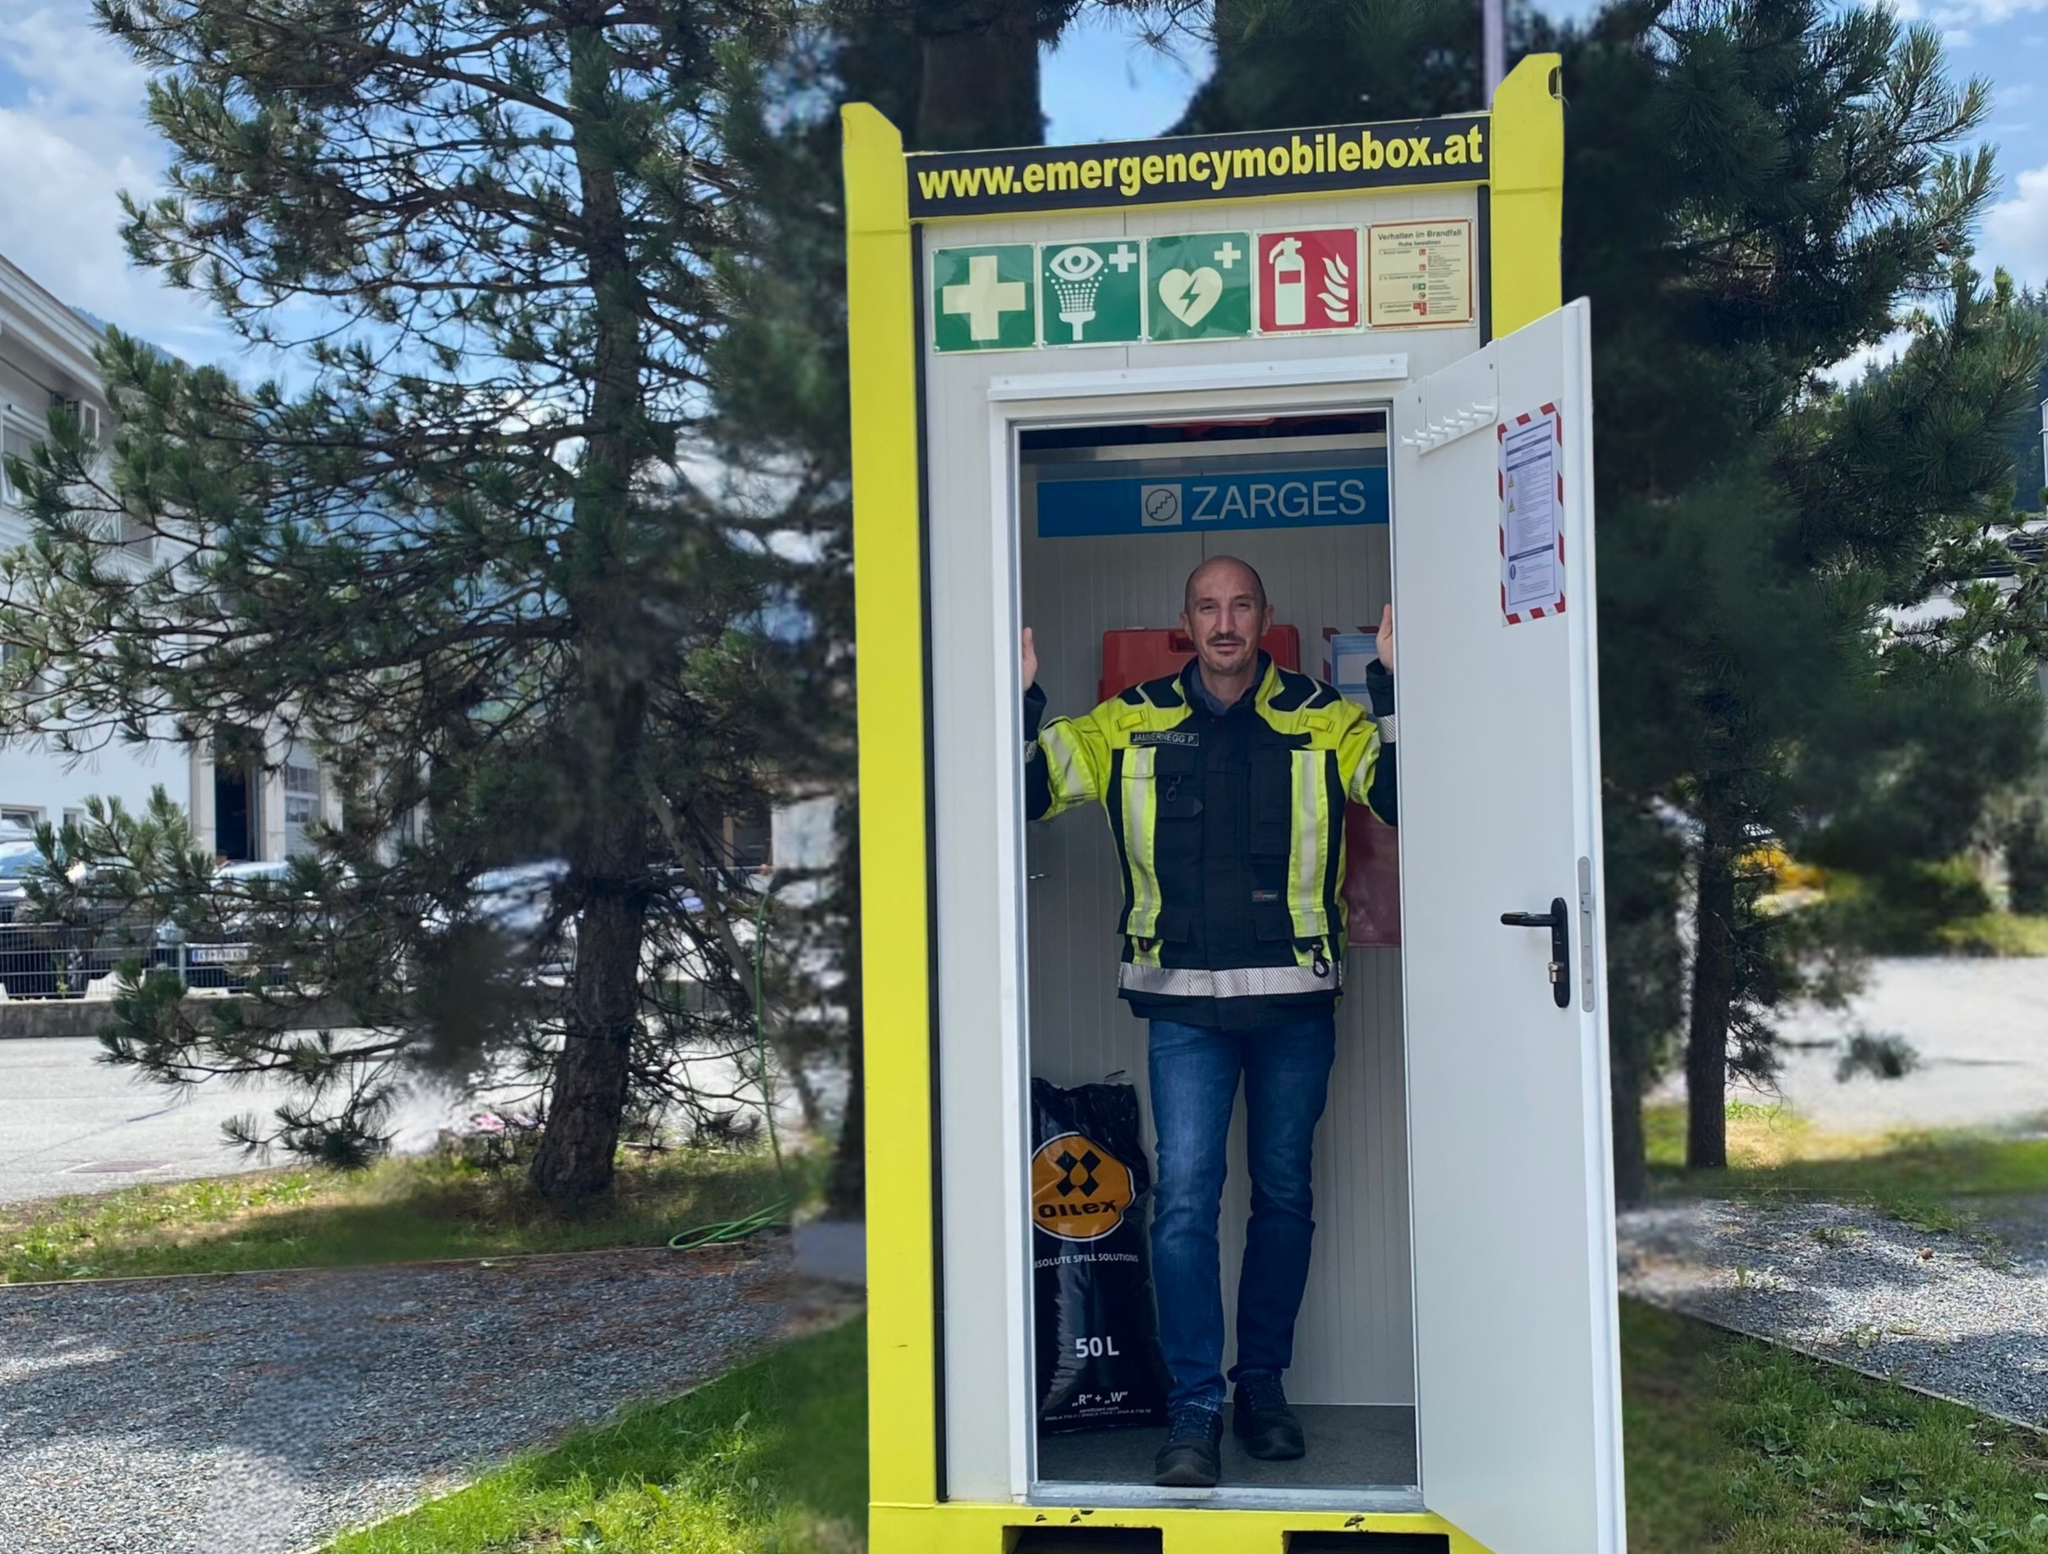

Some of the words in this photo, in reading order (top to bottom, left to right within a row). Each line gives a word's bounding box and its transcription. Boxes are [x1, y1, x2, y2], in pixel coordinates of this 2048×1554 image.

[917, 124, 1483, 200] www.emergencymobilebox.at
[1378, 232, 1413, 241] Verhalten
[1416, 231, 1425, 239] im
[1427, 229, 1462, 237] Brandfall
[1191, 479, 1366, 521] ZARGES
[1034, 1255, 1072, 1268] BSOLUTE
[1073, 1253, 1096, 1263] SPILL
[1098, 1253, 1139, 1263] SOLUTIONS
